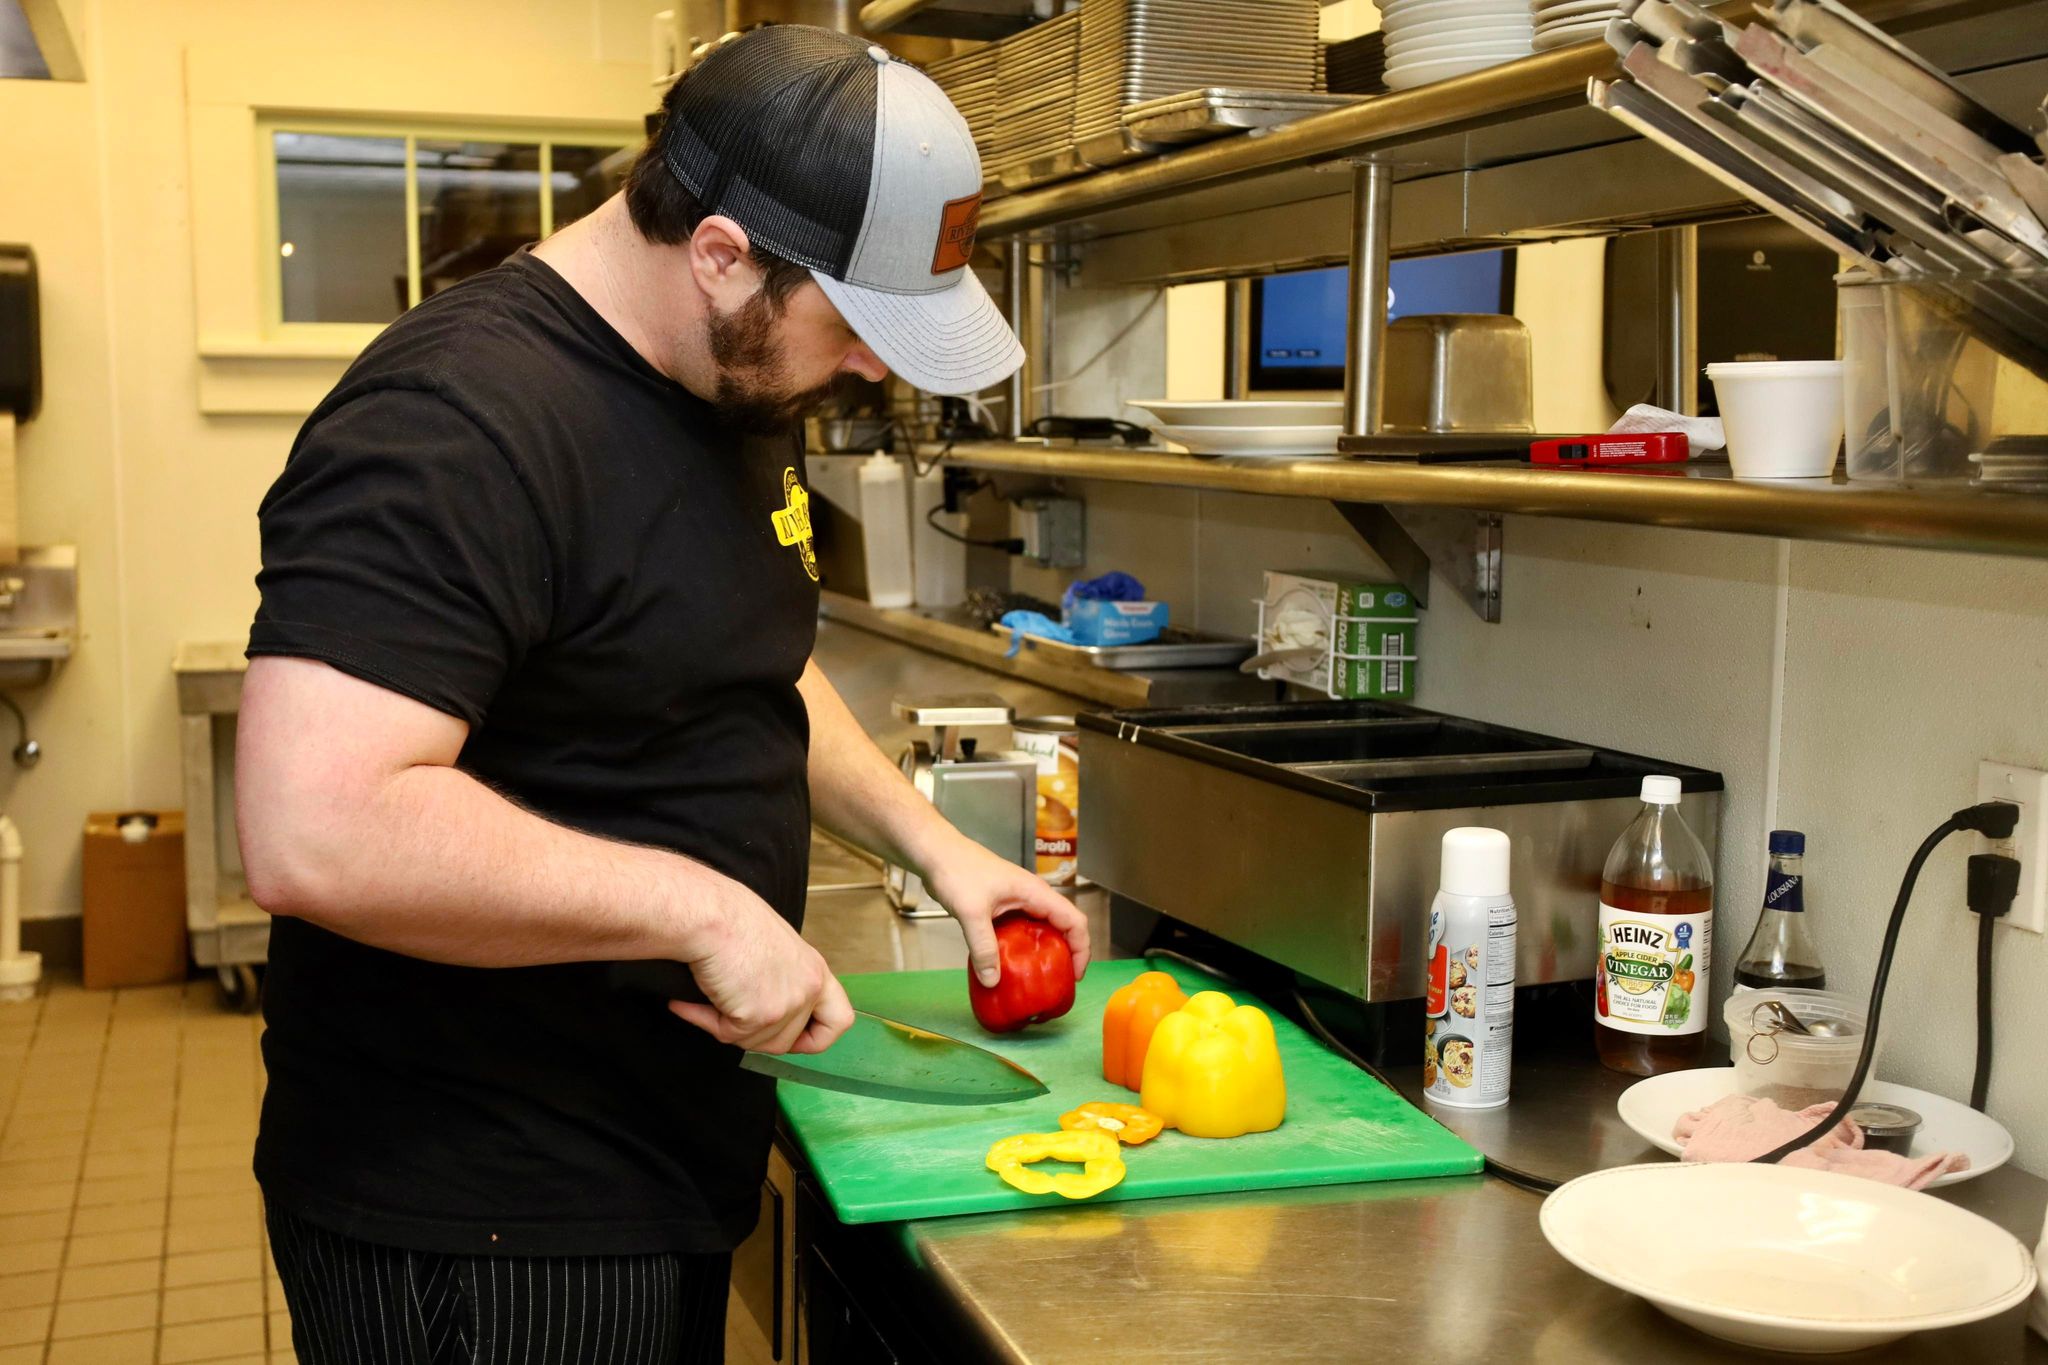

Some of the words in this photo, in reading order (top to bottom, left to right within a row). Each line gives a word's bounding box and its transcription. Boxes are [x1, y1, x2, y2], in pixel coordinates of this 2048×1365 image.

[1036, 839, 1071, 853] Broth
[1767, 876, 1798, 903] LOUISIANA
[1613, 927, 1664, 949] HEINZ
[1616, 951, 1635, 959] APPLE
[1636, 953, 1658, 963] CIDER
[1608, 959, 1668, 978] VINEGAR
